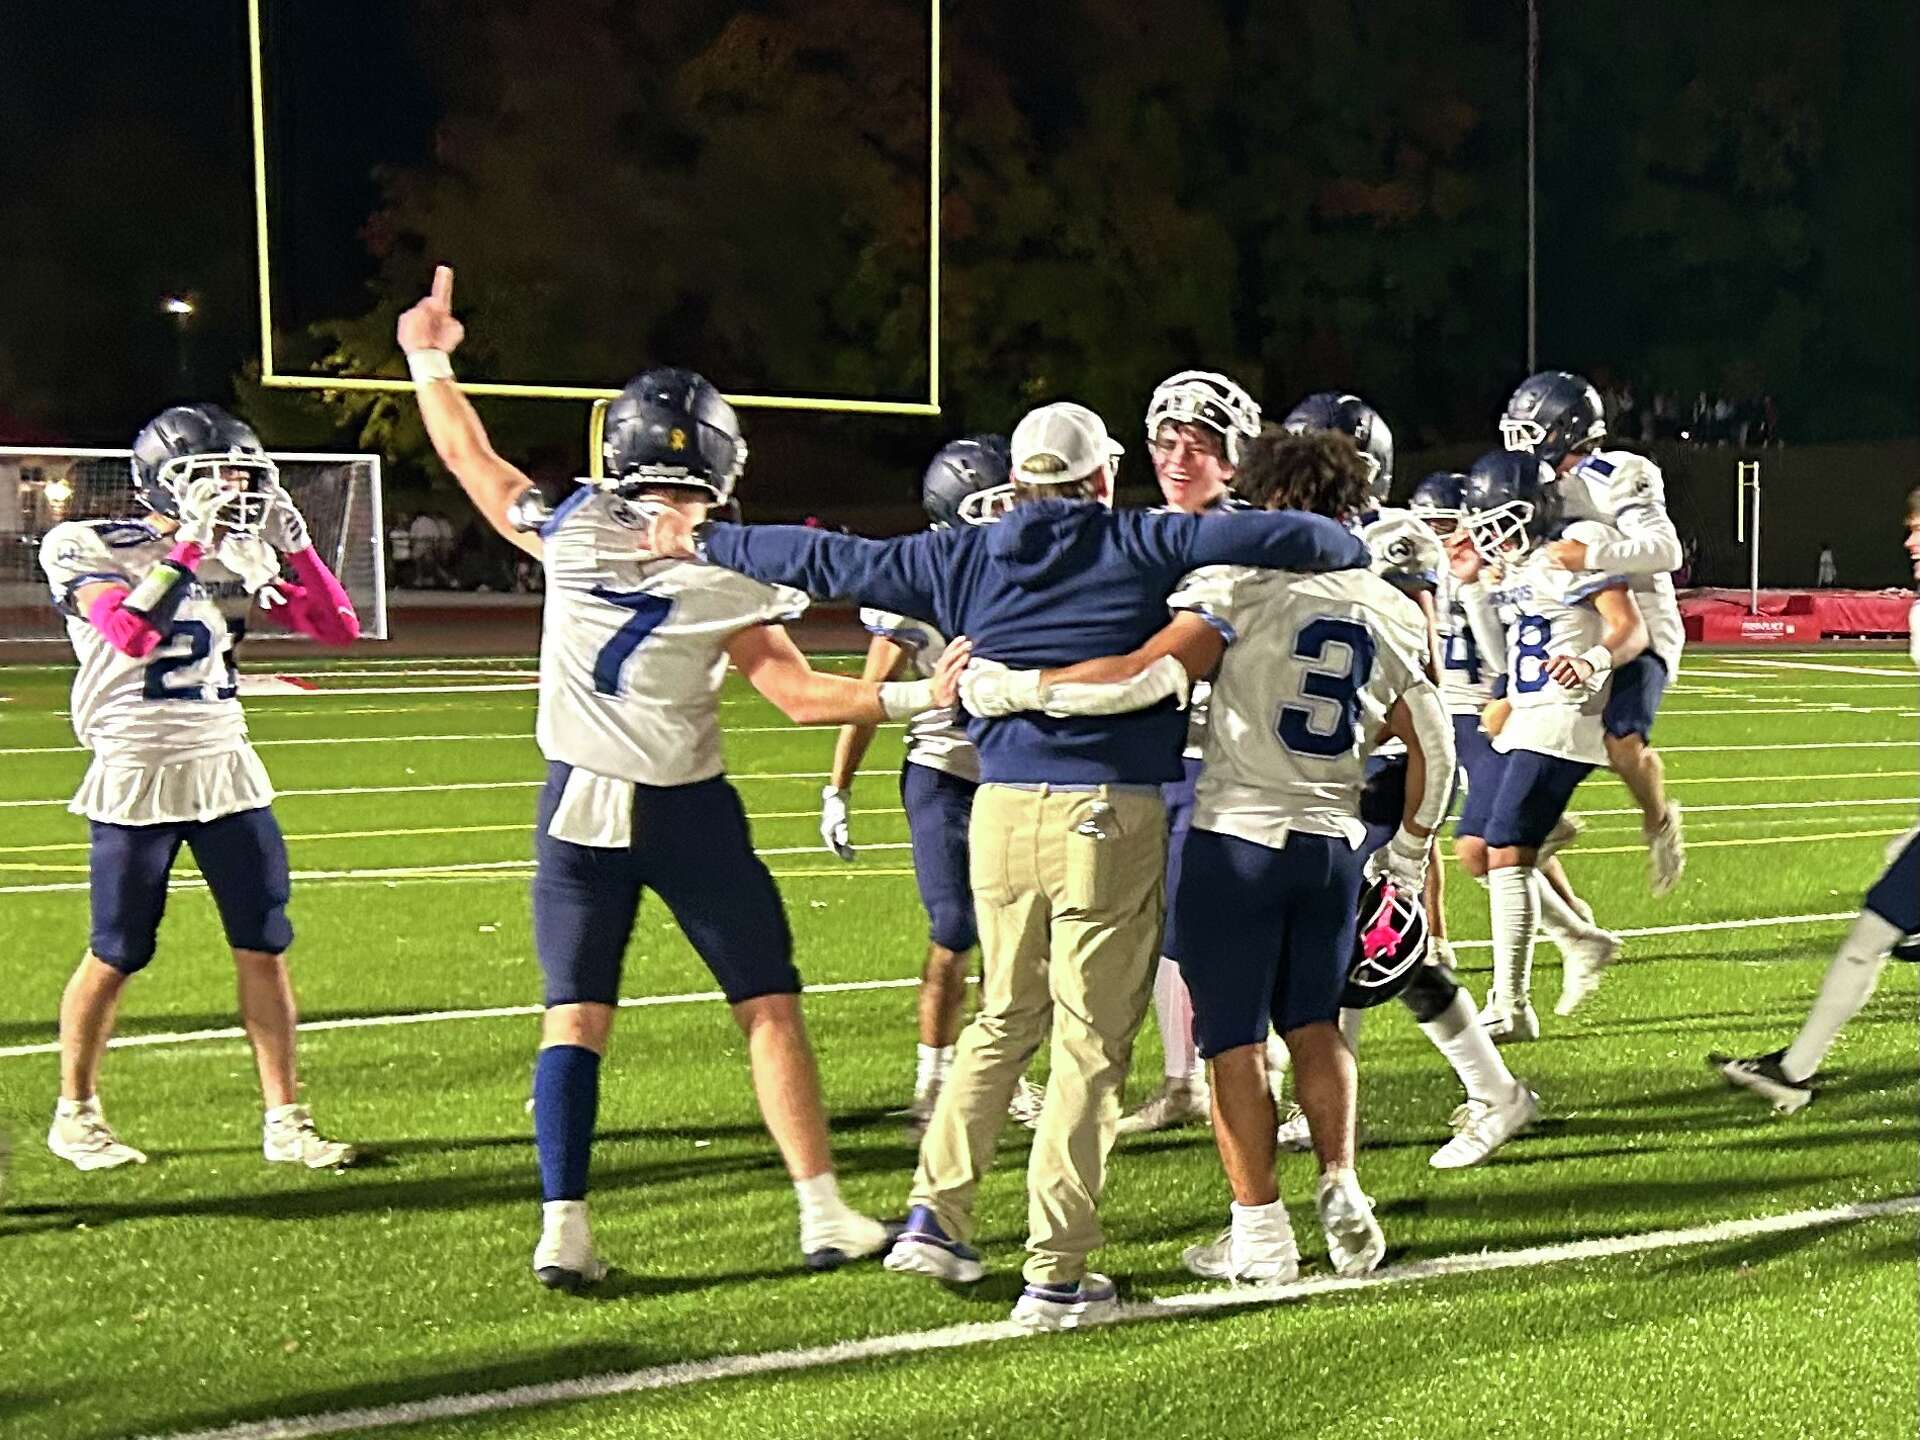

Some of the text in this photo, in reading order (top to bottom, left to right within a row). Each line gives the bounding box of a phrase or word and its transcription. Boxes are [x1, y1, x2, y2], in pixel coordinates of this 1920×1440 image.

[589, 586, 674, 698] 7
[1274, 612, 1377, 761] 3
[1516, 613, 1552, 694] 8
